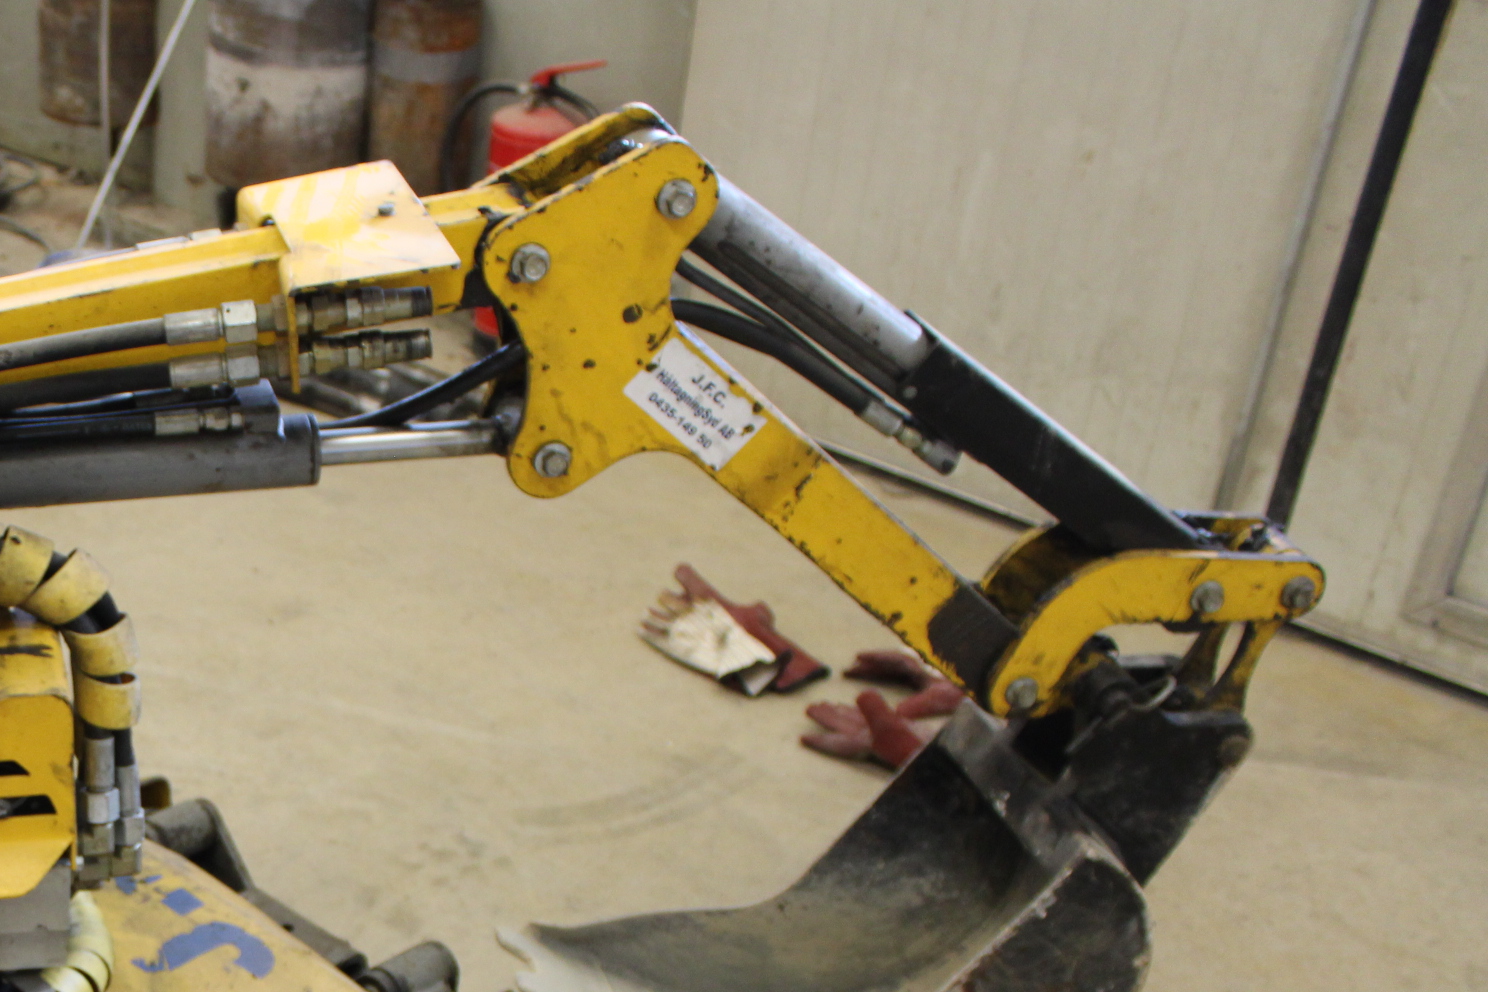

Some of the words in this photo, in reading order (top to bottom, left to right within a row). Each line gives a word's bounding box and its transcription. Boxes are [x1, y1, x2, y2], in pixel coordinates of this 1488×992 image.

[691, 373, 725, 409] J.F.C.
[648, 392, 698, 436] 0435-149
[696, 432, 713, 449] 50
[717, 423, 735, 440] AB
